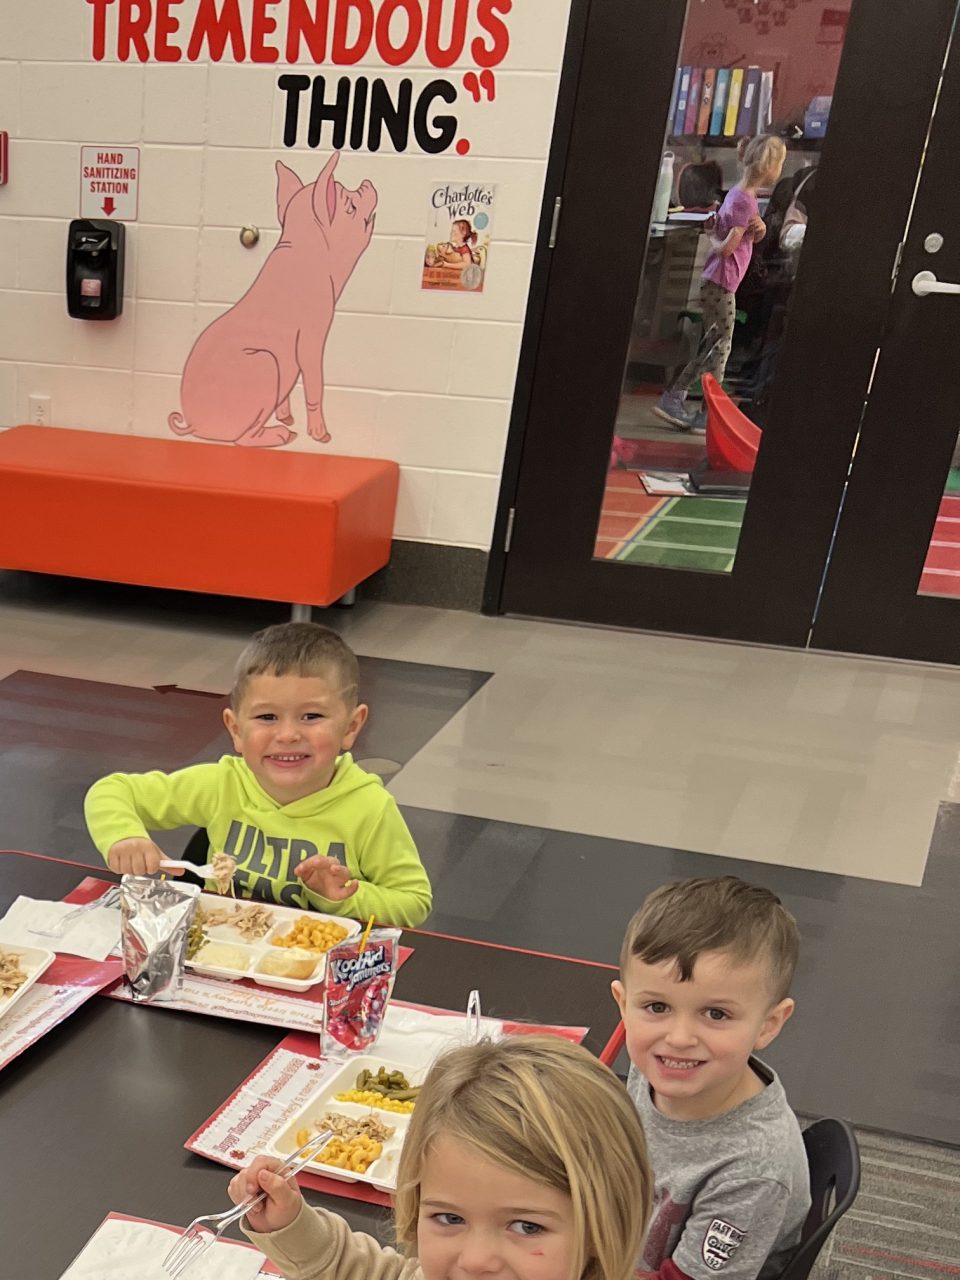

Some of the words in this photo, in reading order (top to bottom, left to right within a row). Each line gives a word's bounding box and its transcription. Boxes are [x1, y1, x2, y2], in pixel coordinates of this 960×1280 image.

[85, 0, 512, 68] TREMENDOUS
[97, 153, 123, 165] HAND
[83, 167, 136, 181] SANITIZING
[90, 182, 129, 194] STATION
[431, 184, 493, 209] Charlotte's
[447, 202, 476, 220] Web
